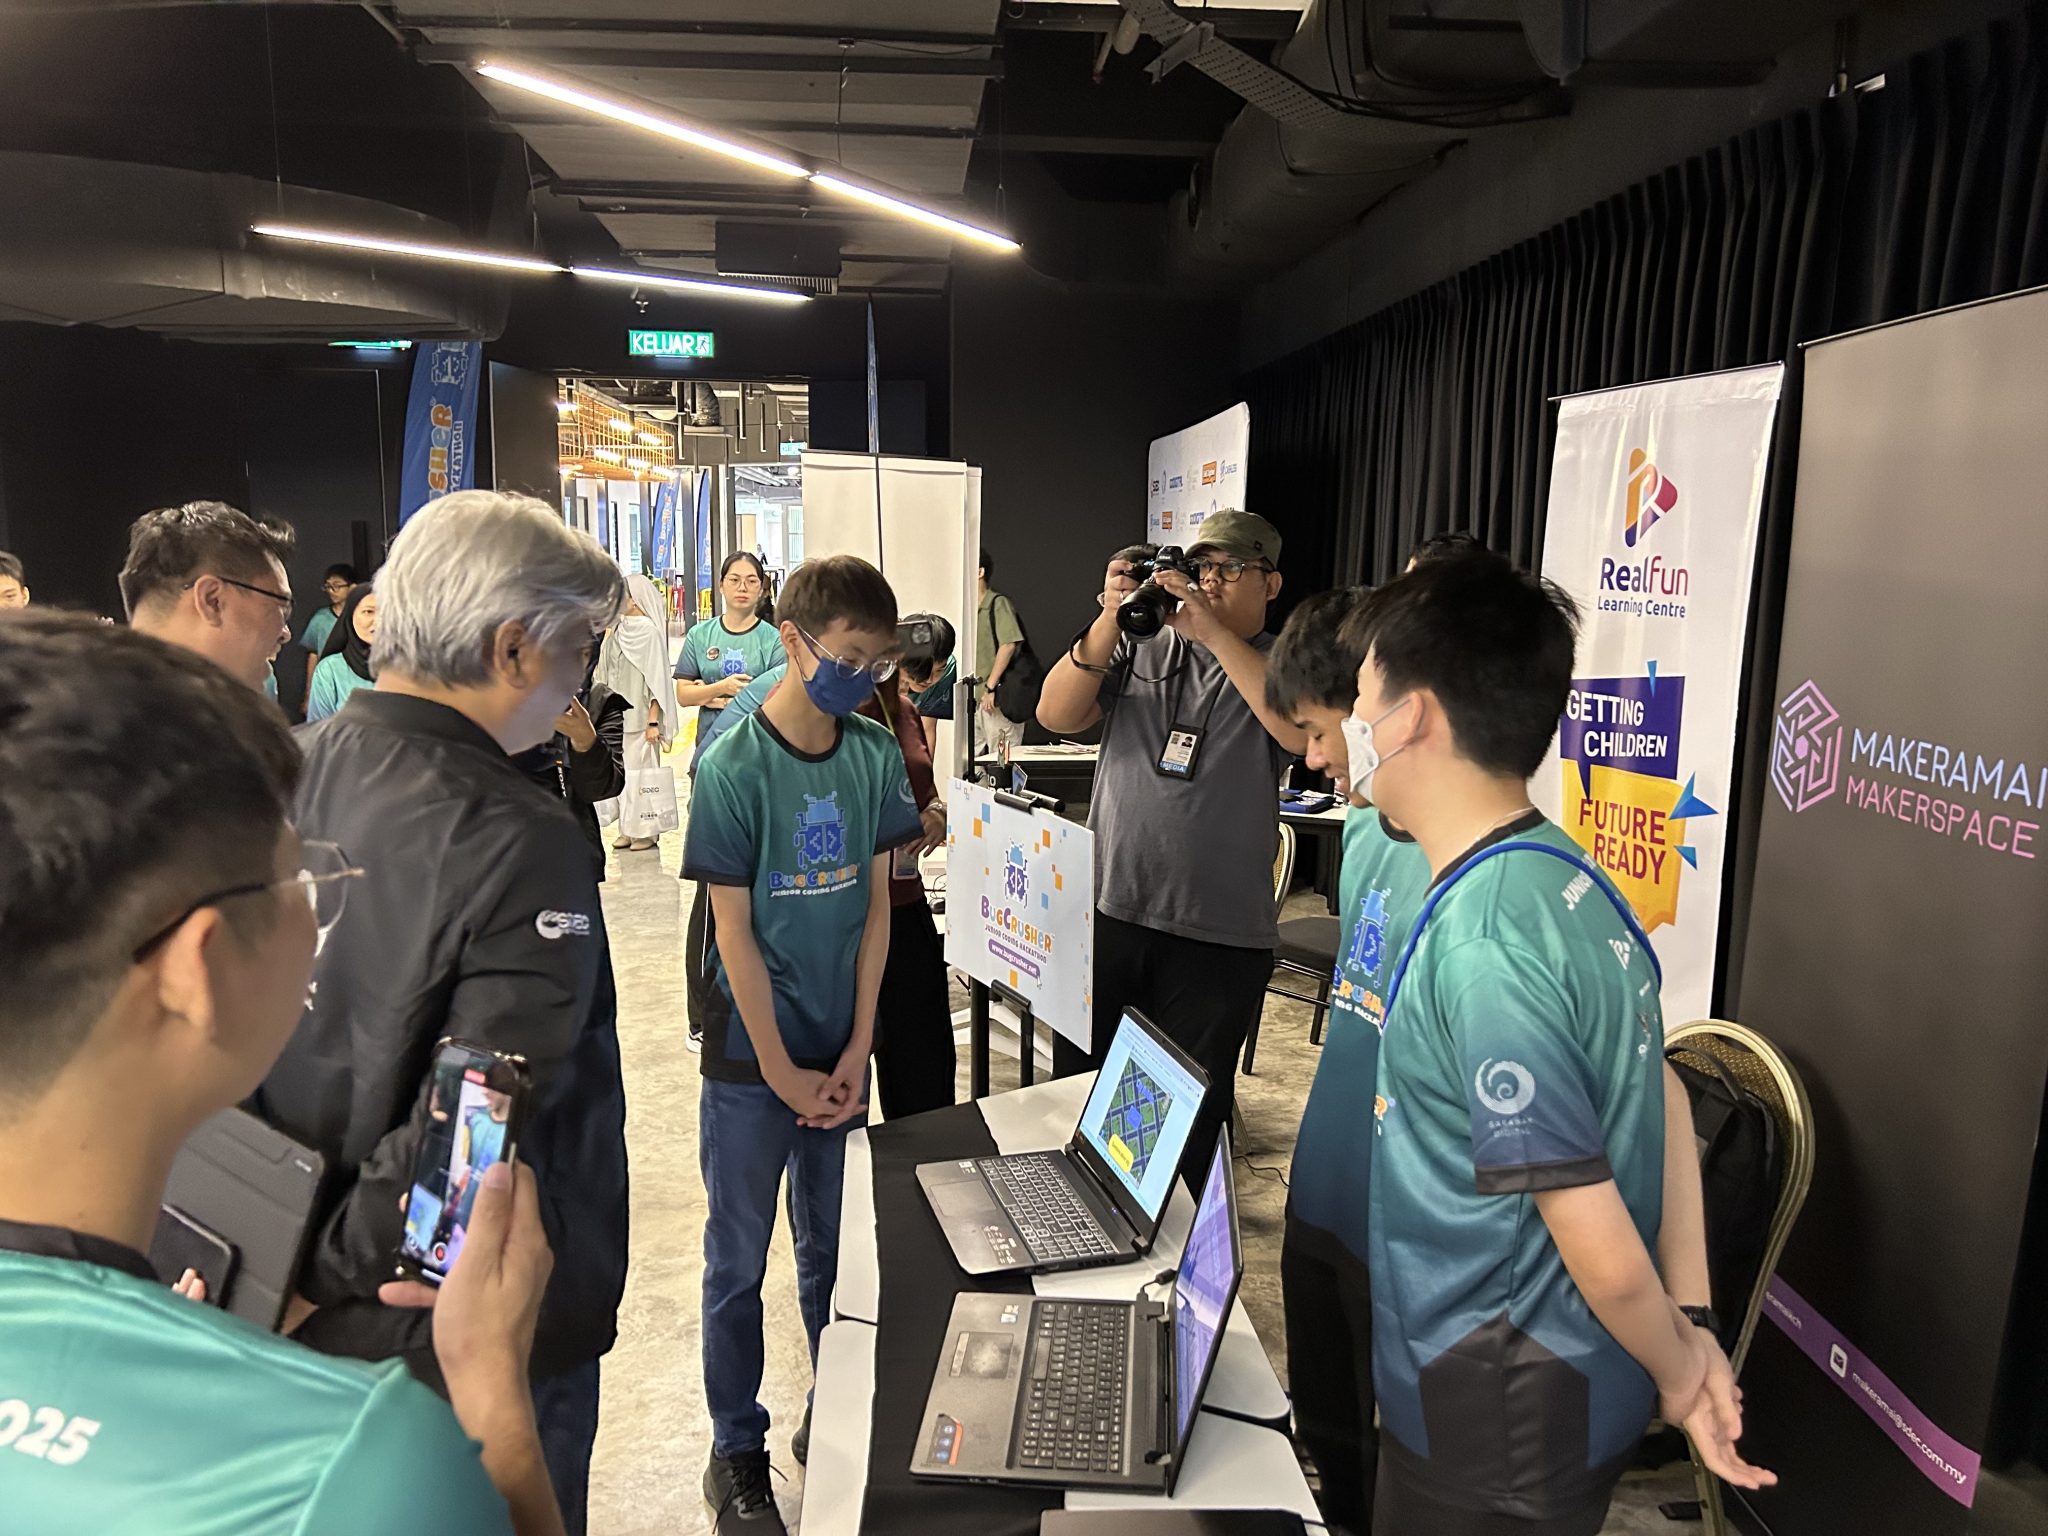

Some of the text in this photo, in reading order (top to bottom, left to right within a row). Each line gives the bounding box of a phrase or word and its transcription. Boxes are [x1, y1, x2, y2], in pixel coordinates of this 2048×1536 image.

[632, 333, 694, 354] KELUAR
[1598, 596, 1685, 618] Learning Centre
[1566, 689, 1644, 727] GETTING
[1584, 731, 1667, 757] CHILDREN
[1162, 763, 1184, 772] MEDIA
[1851, 728, 2048, 810] MAKERAMAI
[1579, 798, 1666, 846] FUTURE
[1846, 775, 2040, 859] MAKERSPACE
[1593, 832, 1667, 885] READY
[991, 943, 1037, 976] www.bugcrusher.net
